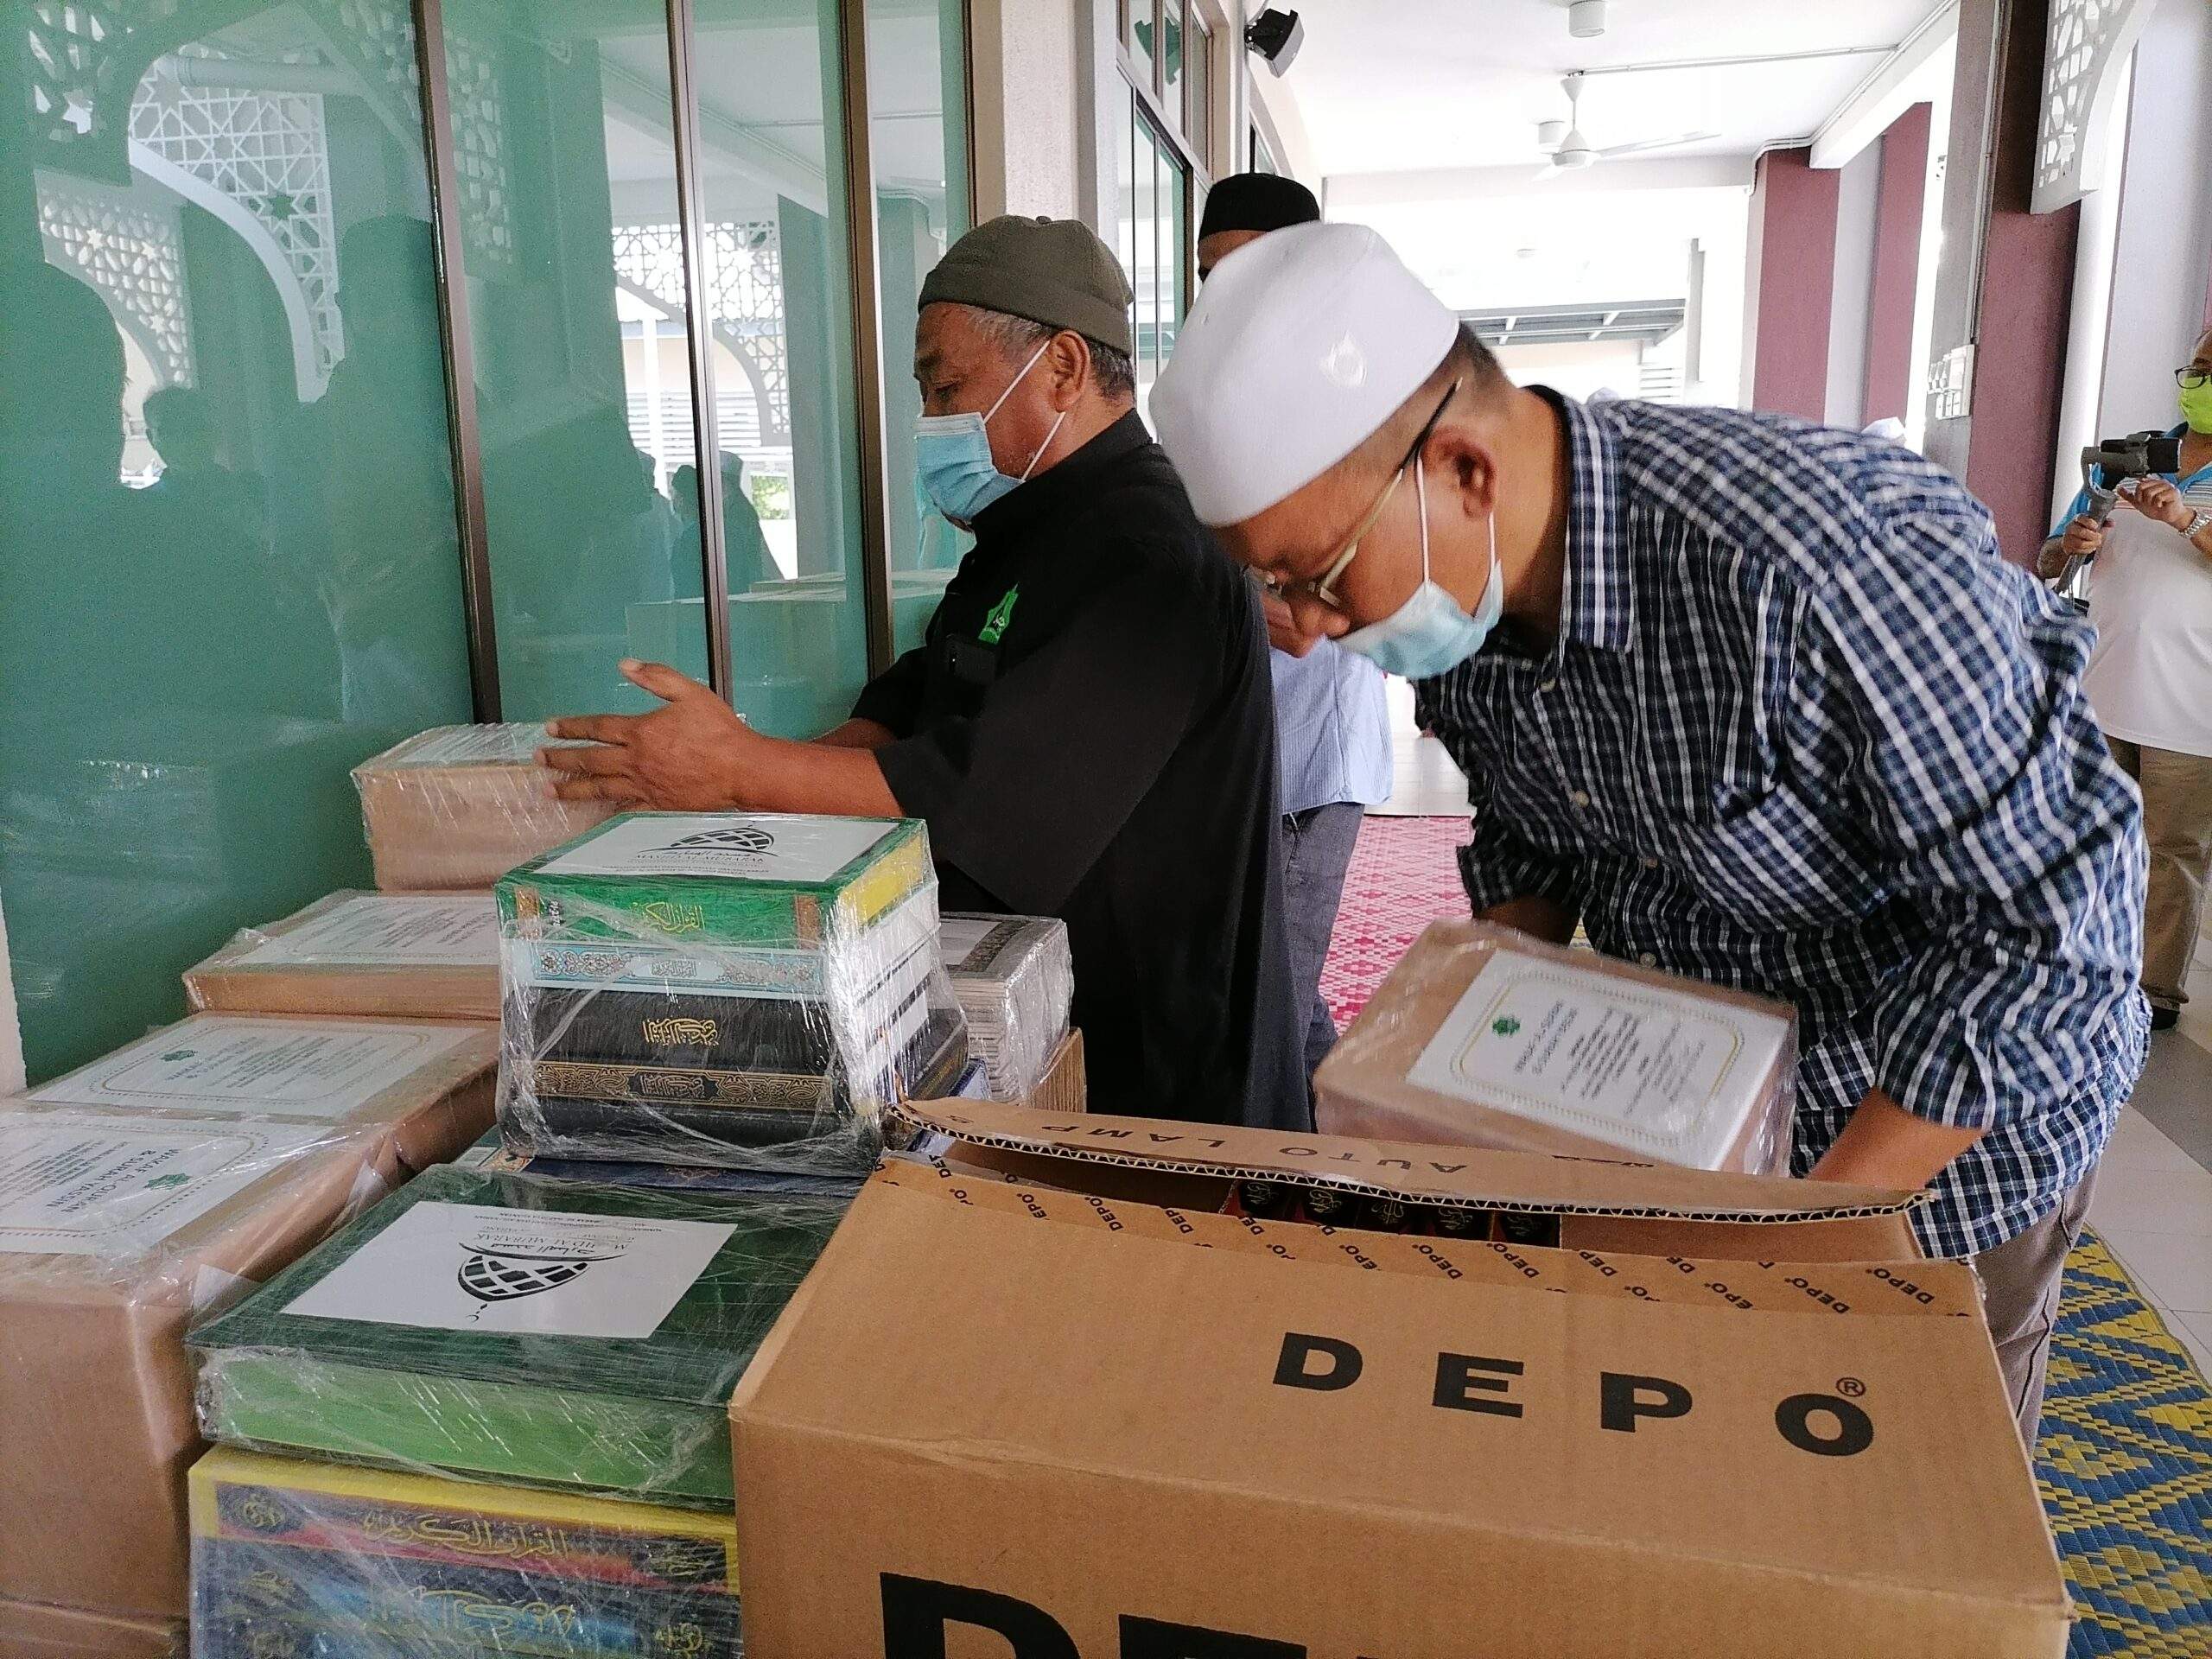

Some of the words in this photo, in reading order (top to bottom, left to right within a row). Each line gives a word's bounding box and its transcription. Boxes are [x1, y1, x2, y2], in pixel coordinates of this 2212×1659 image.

[99, 1155, 145, 1181] SURAH
[137, 1148, 181, 1173] WAKAF
[1279, 1147, 1469, 1173] AUTO
[1084, 1196, 1123, 1231] DEPO
[1412, 1243, 1463, 1280] DEPO
[1486, 1242, 1540, 1279] DEPO
[1784, 1277, 1850, 1314] DEPO
[1866, 1268, 1936, 1305] DEPO
